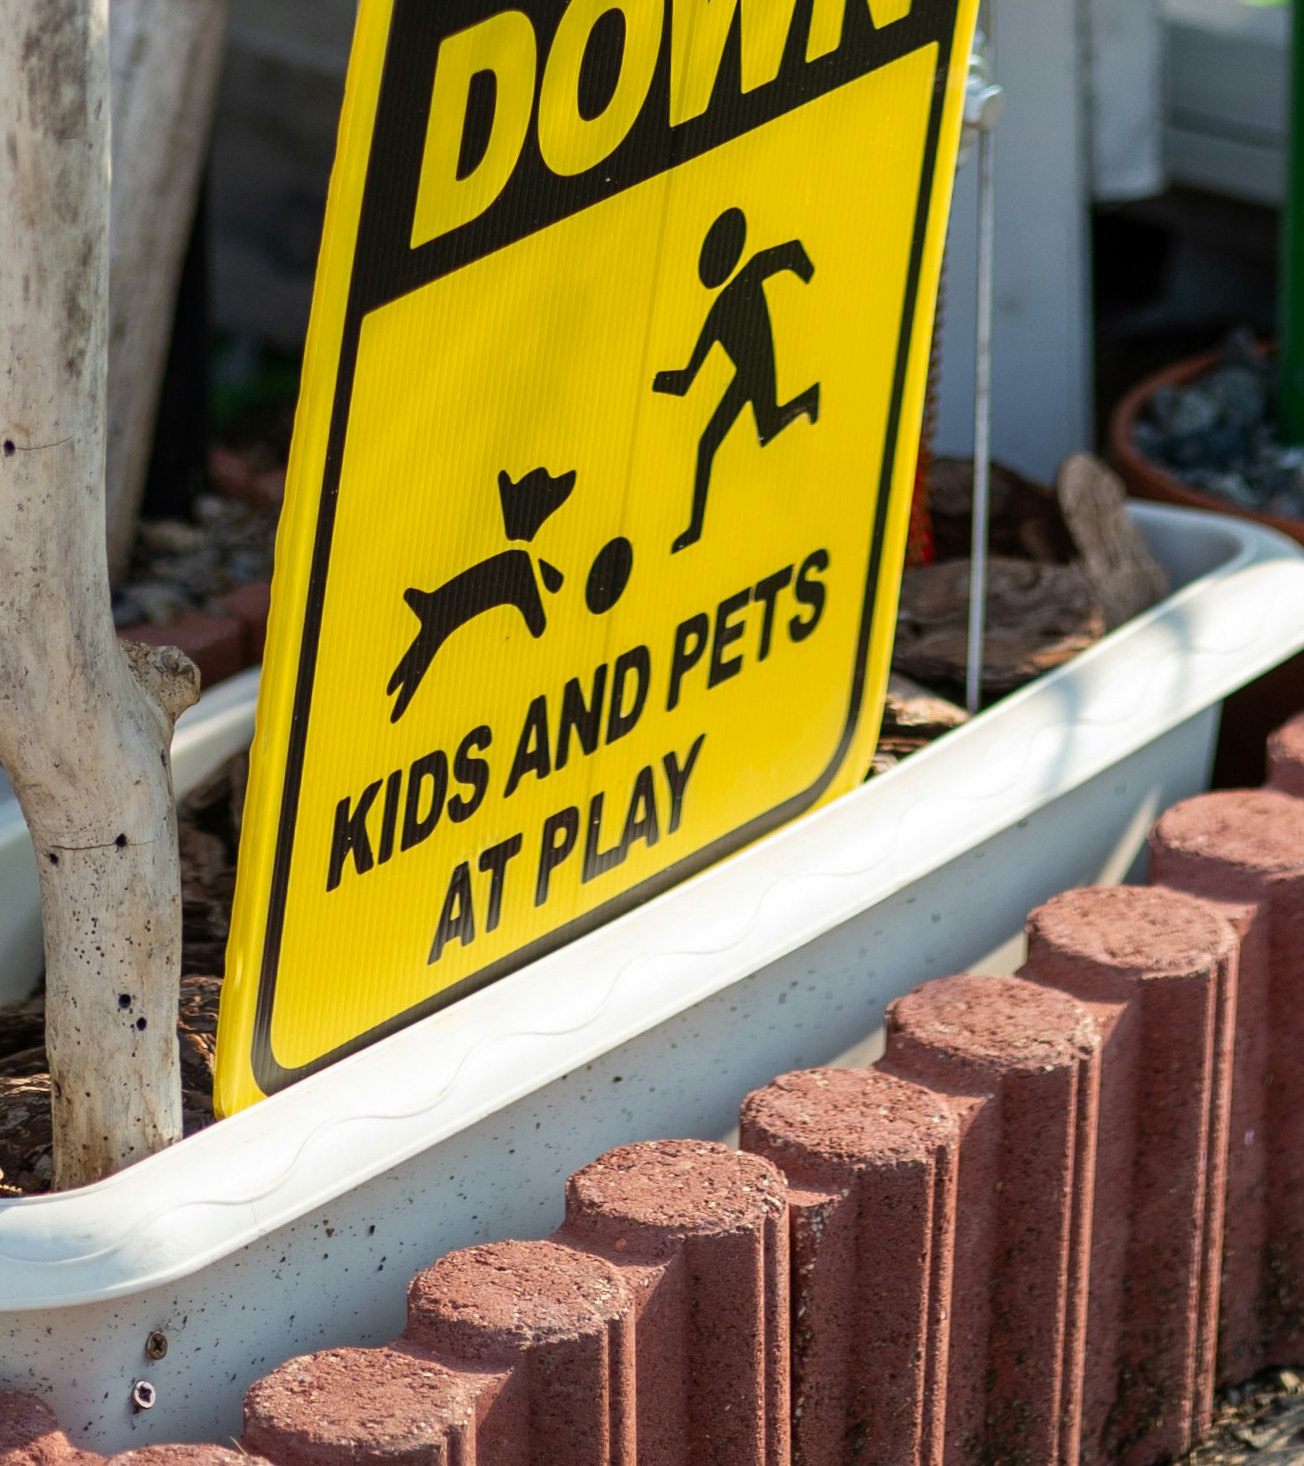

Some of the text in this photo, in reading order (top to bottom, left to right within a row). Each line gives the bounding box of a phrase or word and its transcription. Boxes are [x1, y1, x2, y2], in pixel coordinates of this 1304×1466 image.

[326, 548, 830, 893] KIDS AND PETS
[428, 733, 708, 967] AT PLAY
